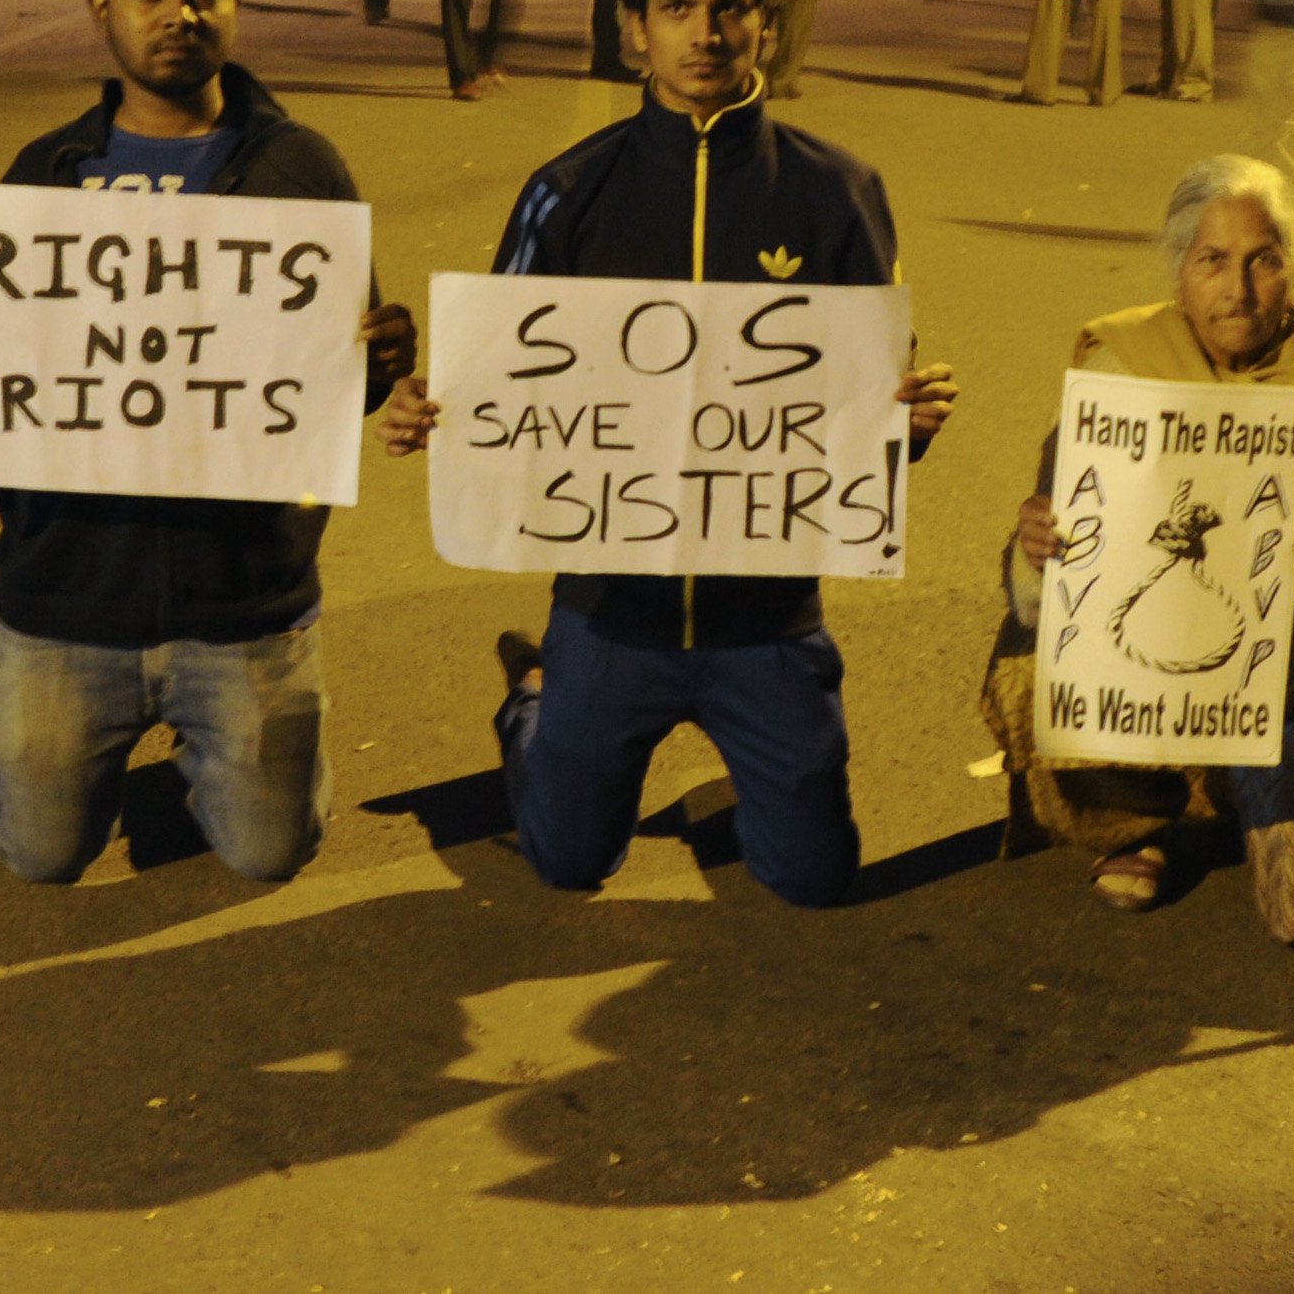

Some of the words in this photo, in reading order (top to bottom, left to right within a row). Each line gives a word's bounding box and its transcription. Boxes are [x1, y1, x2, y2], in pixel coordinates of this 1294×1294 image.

[85, 323, 218, 368] NOT
[0, 374, 303, 435] RIOTS
[468, 401, 635, 451] SAVE
[692, 401, 827, 456] OUR
[1075, 399, 1148, 462] Hang
[1160, 410, 1207, 454] The
[519, 438, 902, 559] SISTERS!
[1050, 681, 1087, 729] We
[1098, 685, 1166, 736] Want
[1173, 691, 1270, 738] Justice
